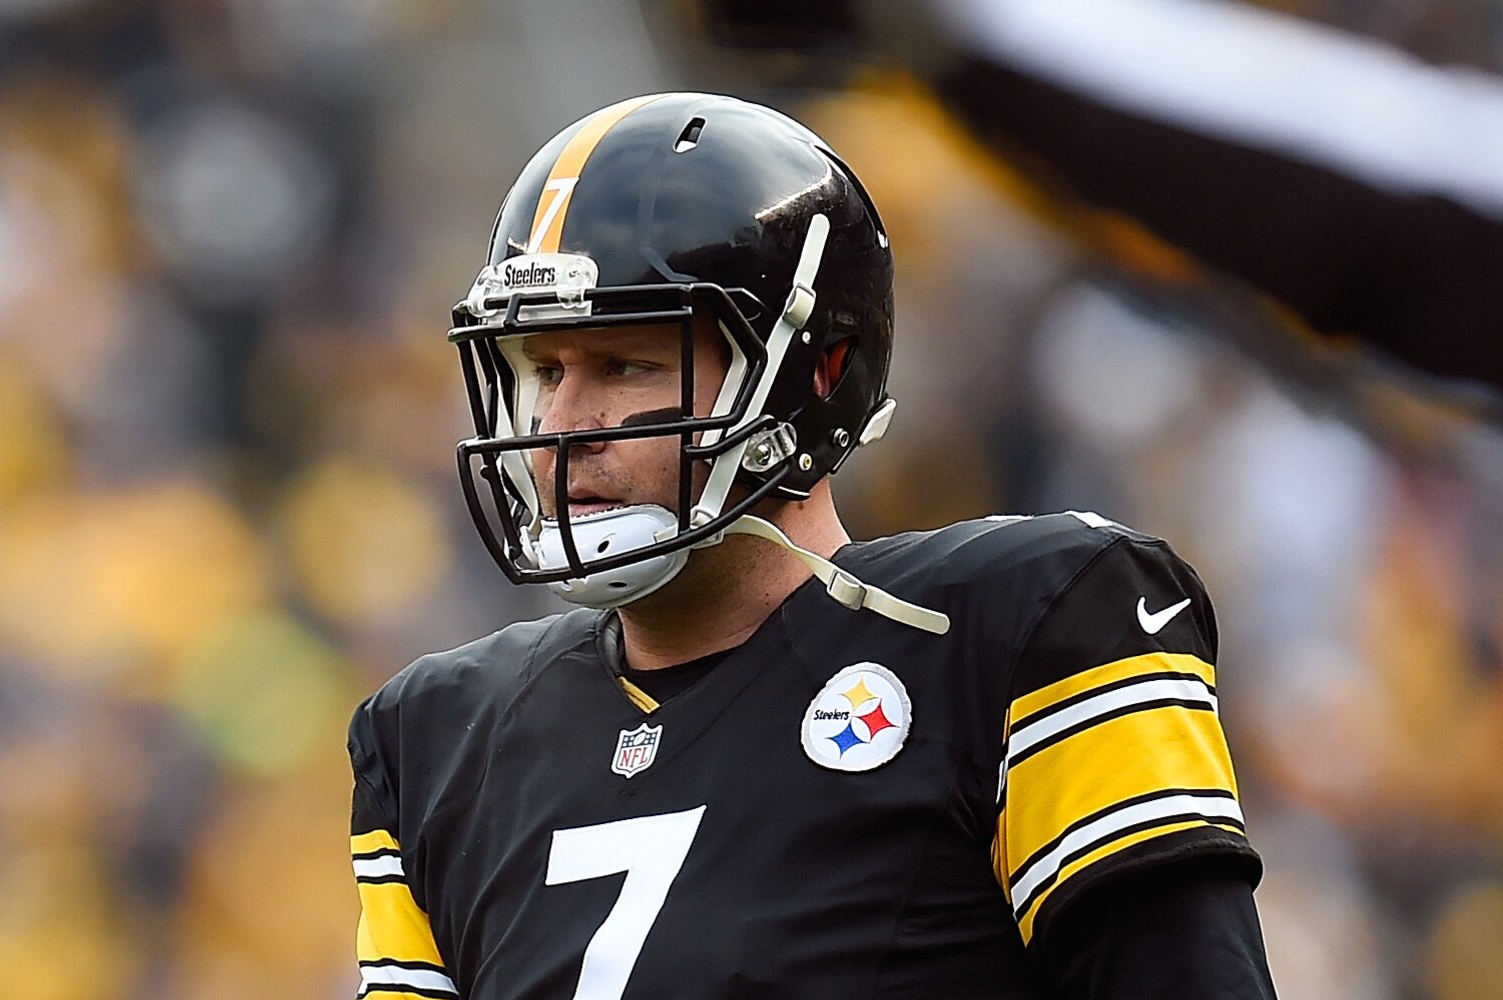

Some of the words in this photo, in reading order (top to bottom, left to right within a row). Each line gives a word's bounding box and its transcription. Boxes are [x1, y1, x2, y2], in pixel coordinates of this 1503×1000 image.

[525, 177, 580, 254] 7
[504, 261, 556, 287] Steelers
[813, 708, 850, 721] Steelers
[619, 746, 649, 768] NFL
